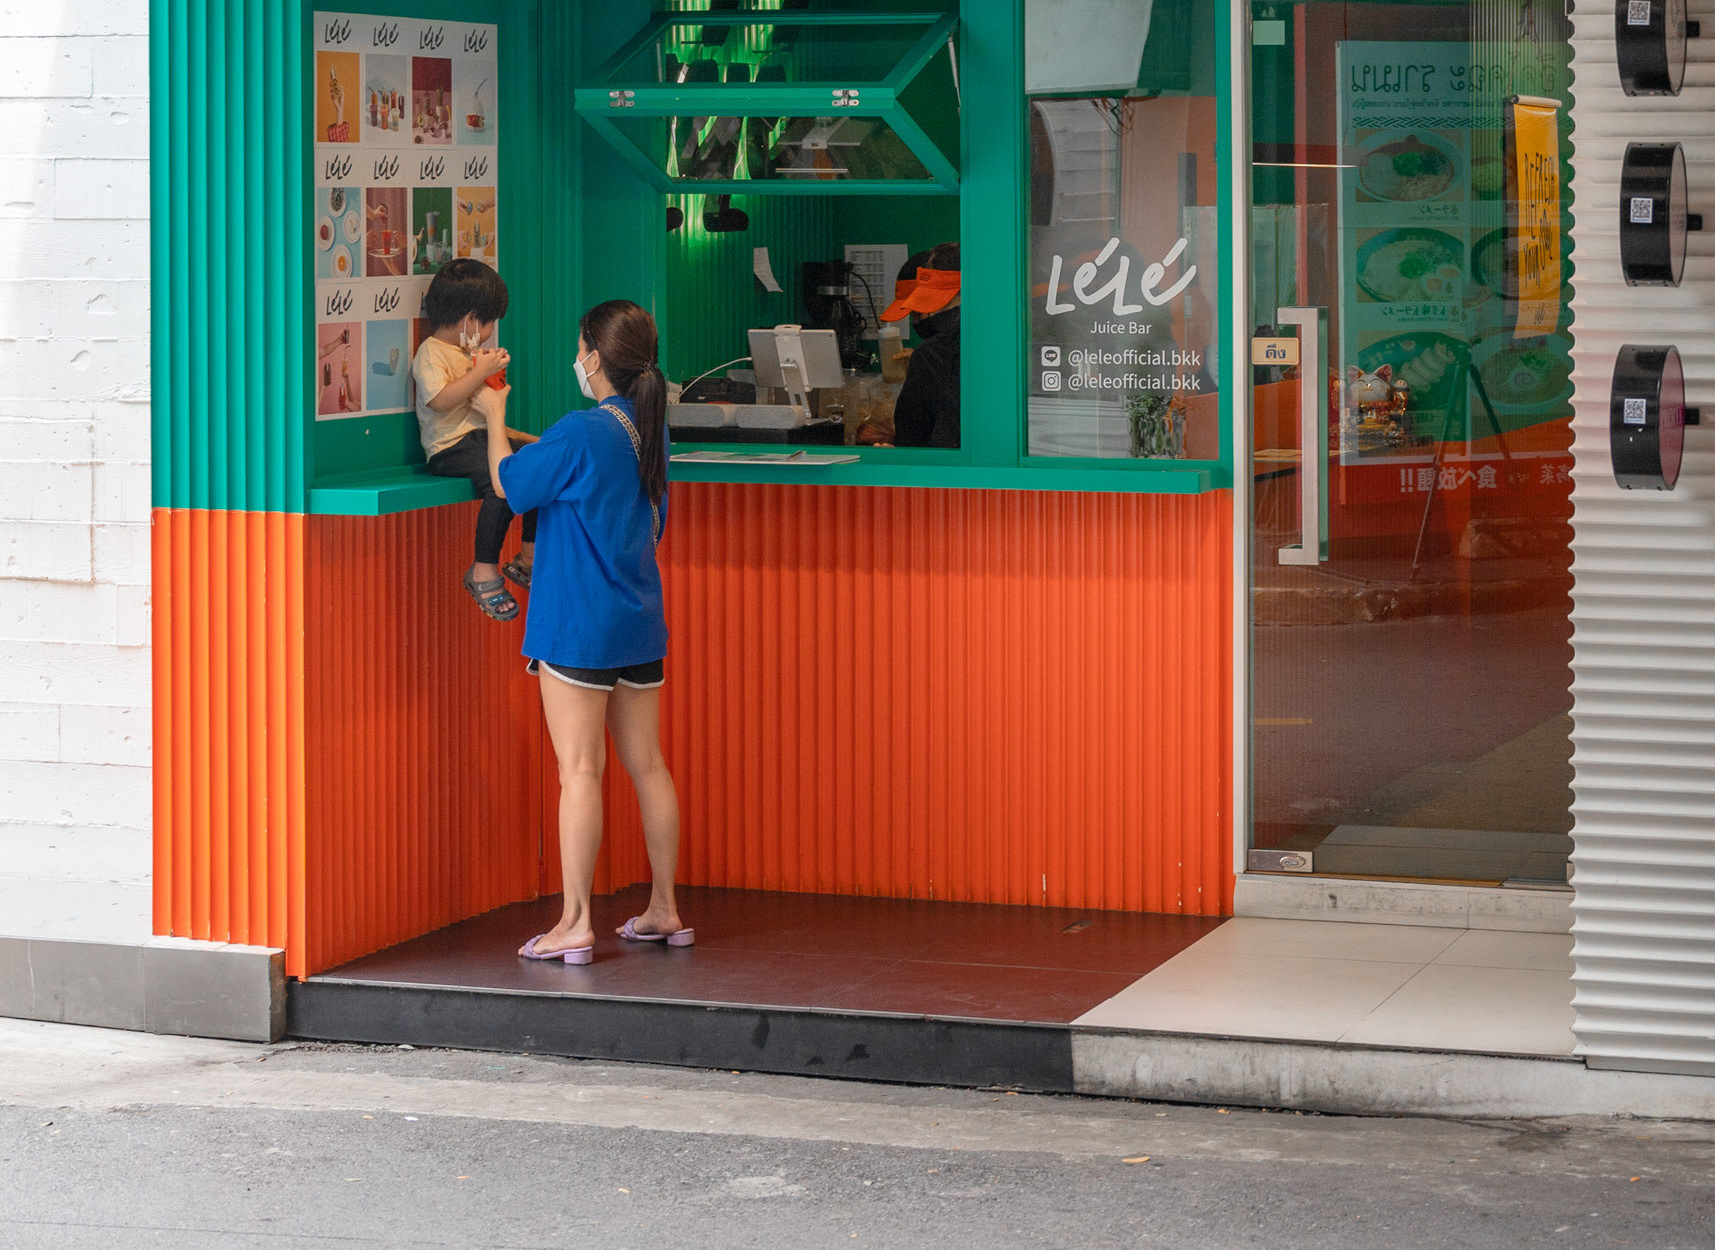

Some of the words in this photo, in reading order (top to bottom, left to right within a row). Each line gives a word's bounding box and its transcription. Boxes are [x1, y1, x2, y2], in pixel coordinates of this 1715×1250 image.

[1090, 321, 1126, 335] Juice
[1128, 321, 1152, 335] Bar
[1068, 348, 1201, 367] @leleofficial.bkk
[1068, 373, 1201, 391] @leleofficial.bkk
